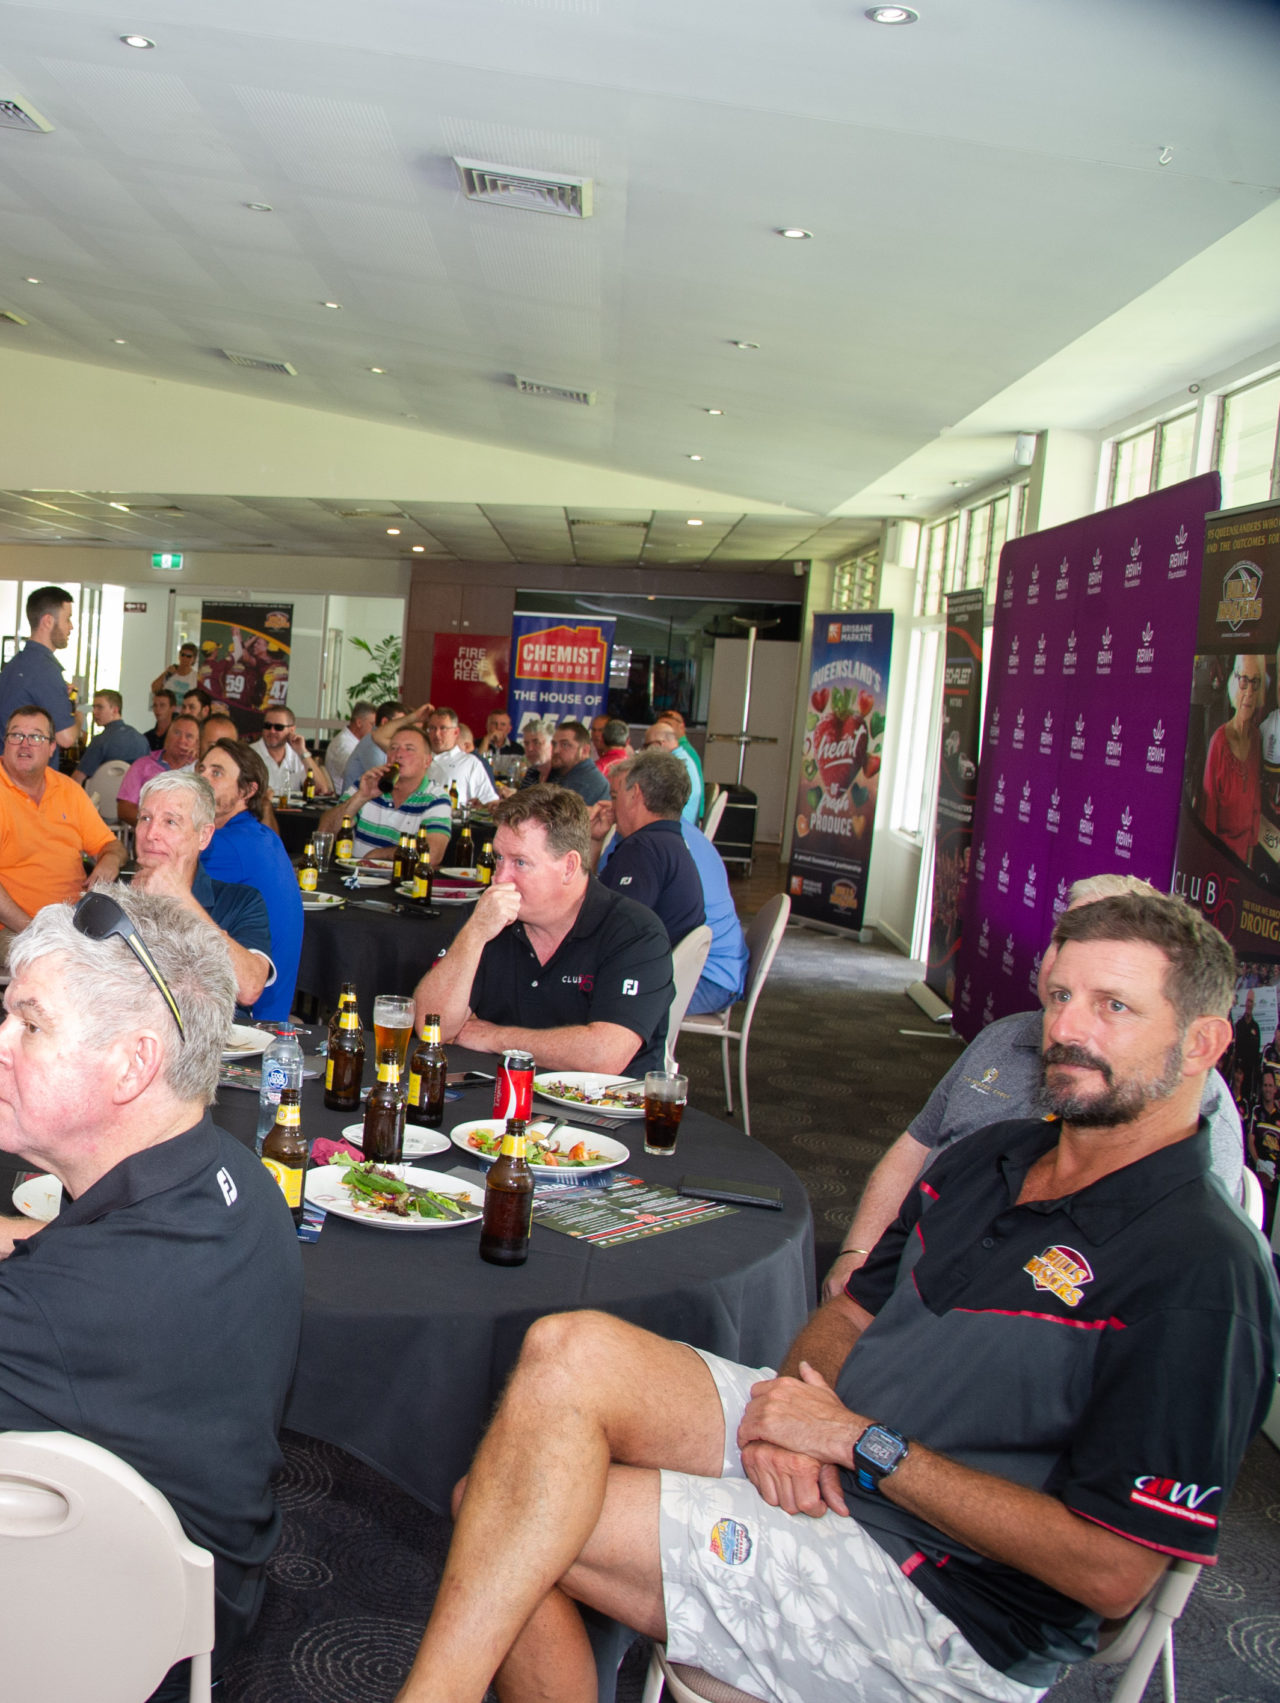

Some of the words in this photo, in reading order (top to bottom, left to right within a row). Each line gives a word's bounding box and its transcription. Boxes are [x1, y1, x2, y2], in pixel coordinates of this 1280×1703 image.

[1169, 550, 1190, 568] RBWH
[841, 623, 873, 633] BRISBANE
[841, 633, 873, 642] MARKETS
[458, 646, 487, 660] FIRE
[522, 643, 601, 665] CHEMIST
[1136, 648, 1154, 663] RBWH
[454, 658, 489, 672] HOSE
[522, 663, 598, 676] WAREHOUSE
[225, 674, 245, 693] 59
[811, 660, 882, 693] QUEENSLAND'S
[270, 681, 288, 699] 47
[514, 690, 537, 702] THE
[539, 692, 582, 705] HOUSE
[584, 694, 603, 706] OF
[817, 725, 867, 760] heart
[1147, 746, 1166, 762] RBWH
[830, 783, 839, 795] OF
[810, 813, 853, 837] PRODUCE
[1116, 830, 1133, 848] RBWH
[1174, 871, 1216, 905] CLUB
[1240, 911, 1280, 941] DROUG
[622, 978, 639, 996] FJ
[1041, 1247, 1088, 1284] BULLS
